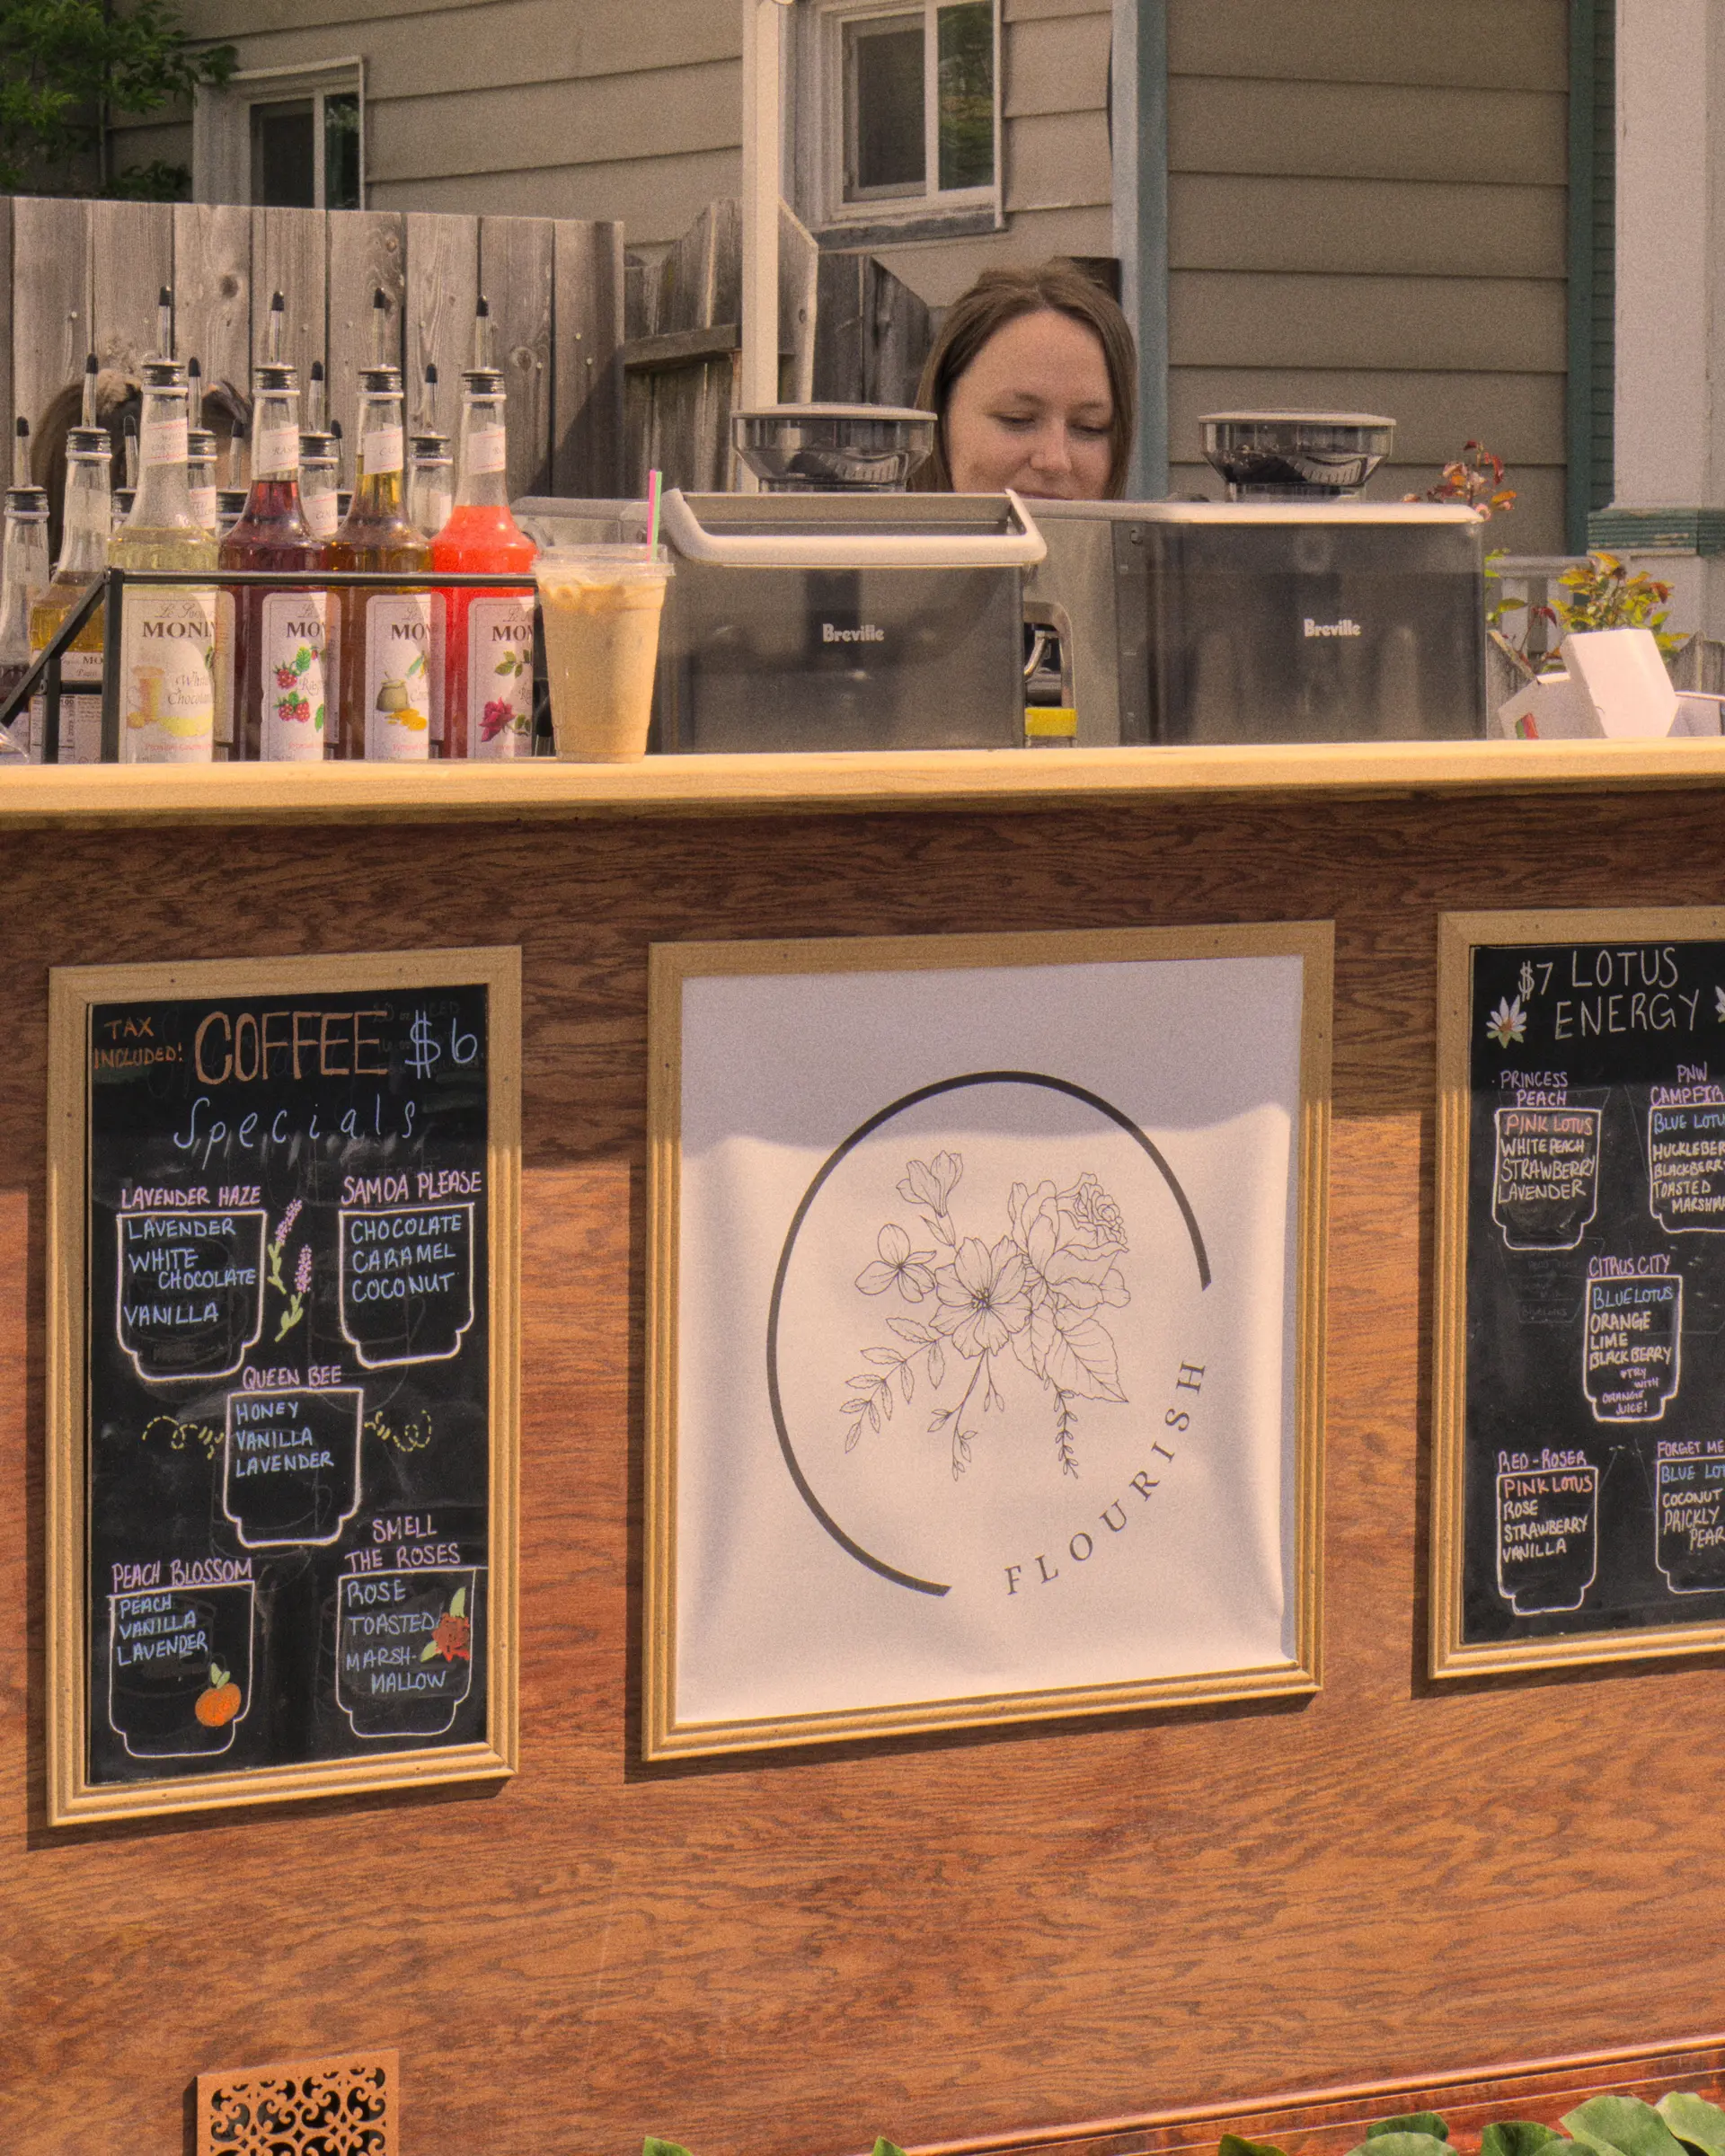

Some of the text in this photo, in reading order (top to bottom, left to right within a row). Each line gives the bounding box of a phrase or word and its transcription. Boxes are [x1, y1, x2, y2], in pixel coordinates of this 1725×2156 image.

[823, 623, 884, 642] Breville
[1304, 618, 1362, 637] Breville
[1517, 947, 1679, 1002] $7 LOTUS
[1555, 988, 1700, 1040] ENERGY
[104, 1016, 155, 1041] TAX
[195, 1011, 388, 1085] COFFEE
[404, 1009, 478, 1079] $6
[1500, 1070, 1569, 1089] PRINCESS
[1676, 1061, 1707, 1082] PNW
[1517, 1089, 1568, 1107] PEACH
[173, 1093, 416, 1171] Specials
[1505, 1114, 1593, 1135] PINK LOTUS
[1654, 1111, 1687, 1134] BLUE
[1500, 1138, 1585, 1157] WHITE PEACH
[1500, 1155, 1596, 1182] STRAWBERRY
[121, 1185, 261, 1210] LAVENDER HAZE
[341, 1171, 482, 1206] SAMOA PLEASE
[1498, 1179, 1587, 1204] LAVENDER
[1653, 1180, 1712, 1198] TOASTED
[128, 1217, 236, 1240] LAVENDER
[350, 1215, 463, 1245] CHOCOLATE
[128, 1247, 199, 1272] WHITE
[352, 1243, 456, 1275] CARAMEL
[1588, 1256, 1634, 1277] CITRUS
[1638, 1254, 1670, 1274] CITY
[158, 1268, 257, 1290] CHOCOLATE
[352, 1272, 456, 1303] COCONUT
[1593, 1286, 1673, 1310] BLUE LOTUS
[124, 1301, 219, 1327] VANILLA
[1590, 1310, 1651, 1334] ORANGE
[1590, 1331, 1628, 1350] LIME
[243, 1365, 341, 1390] QUEEN BEE
[1634, 1377, 1659, 1388] WITH
[1602, 1390, 1645, 1404] ORANGE
[1616, 1401, 1649, 1415] JUICE!
[235, 1401, 299, 1423] HONEY
[235, 1427, 313, 1450] VANILLA
[1658, 1439, 1725, 1458] FORGET ME
[235, 1452, 334, 1478] LAVENDER
[1661, 1465, 1695, 1484] BLUE
[1004, 1361, 1206, 1595] FLOURISH
[1504, 1475, 1593, 1498] PINK LOTUS
[1503, 1499, 1538, 1522] ROSE
[1662, 1489, 1723, 1508] COCONUT
[373, 1514, 438, 1543] SMELL
[1504, 1515, 1588, 1542] STRAWBERRY
[1664, 1506, 1721, 1535] PRICKLY
[1502, 1537, 1567, 1563] VANILLA
[1690, 1526, 1725, 1551] PEAR
[345, 1543, 461, 1574] THE ROSES
[112, 1558, 252, 1592] PEACH BLOSSOM
[348, 1579, 406, 1607] ROSE
[120, 1595, 172, 1619] PEACH
[119, 1611, 197, 1640] VANILLA
[349, 1609, 436, 1636] TOASTED
[118, 1630, 208, 1666] LAVENDER
[346, 1648, 417, 1672] MARSH-
[371, 1670, 447, 1694] MALLOW
